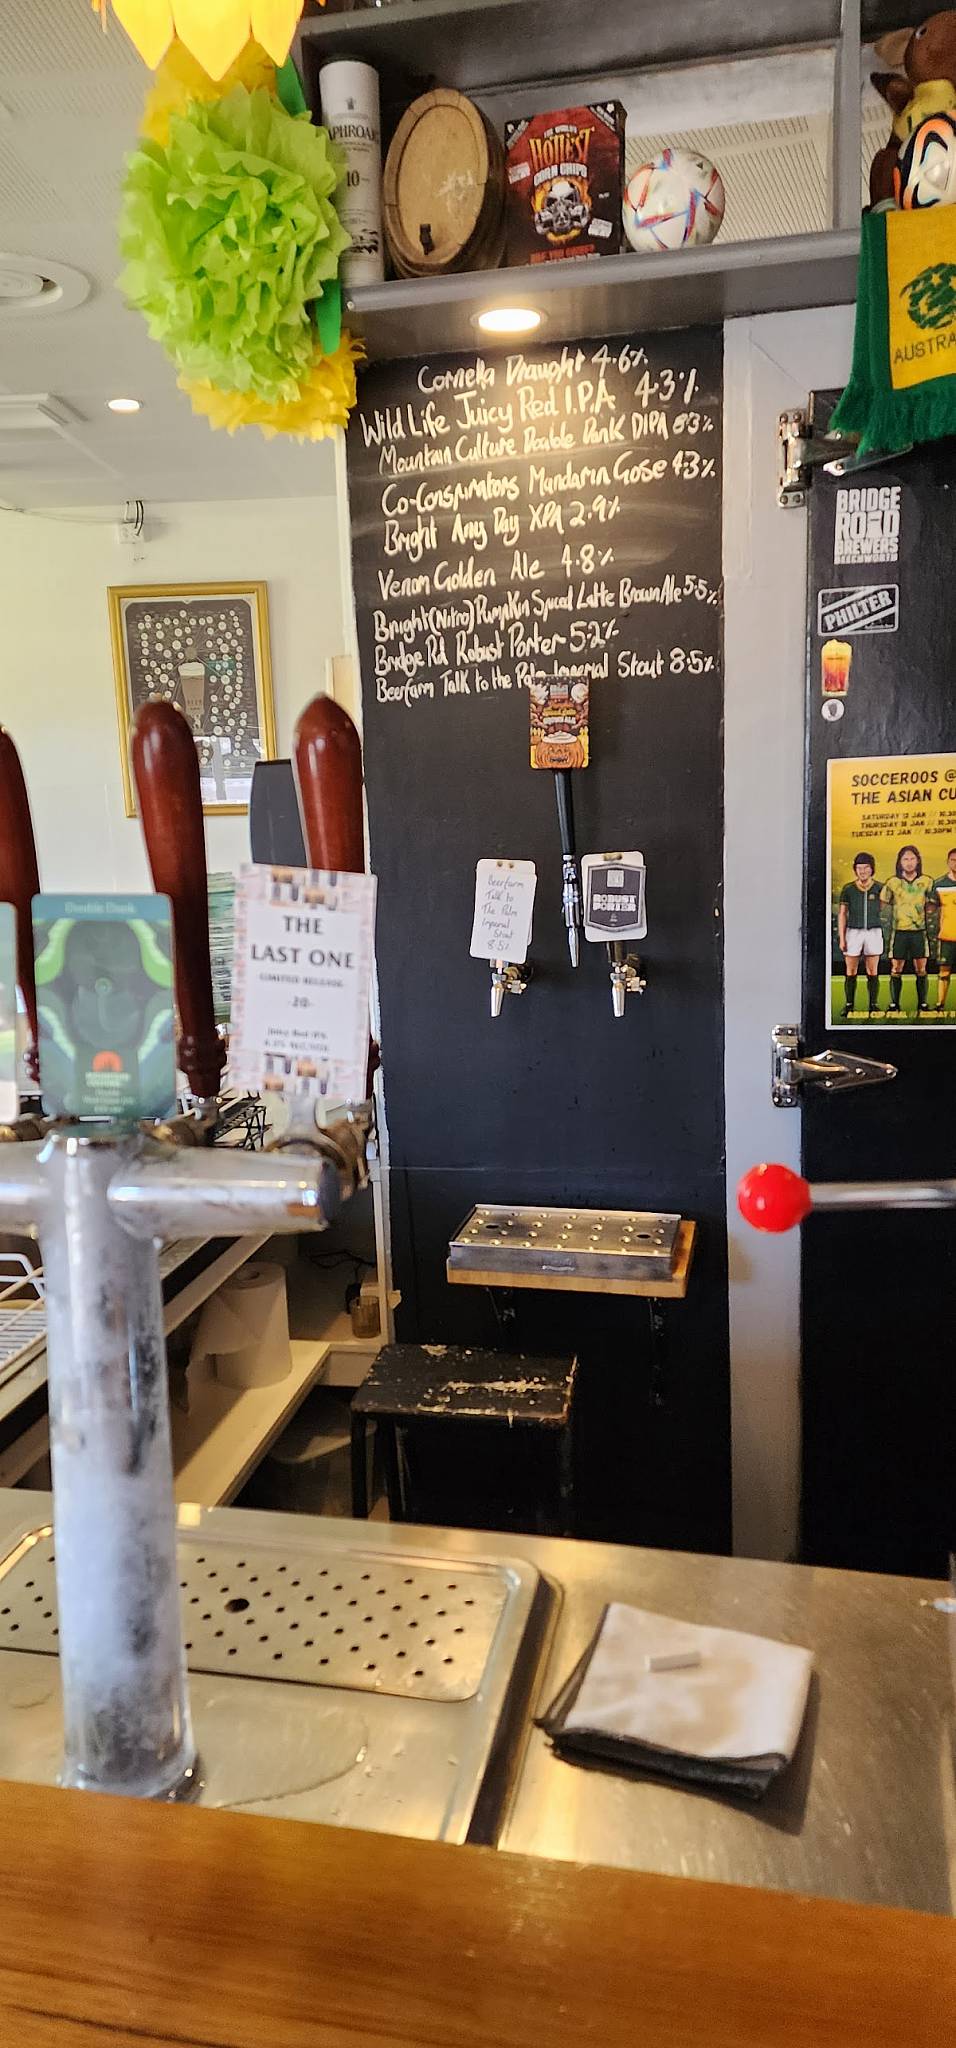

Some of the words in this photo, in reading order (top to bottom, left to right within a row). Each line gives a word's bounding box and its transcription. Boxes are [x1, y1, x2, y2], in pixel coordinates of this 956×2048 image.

[529, 127, 594, 172] HOTTEST
[346, 169, 360, 188] 10
[504, 346, 586, 388] Draught
[591, 344, 650, 378] 4.6%
[359, 406, 404, 448] Wild
[406, 400, 450, 438] Life
[453, 390, 514, 433] Juicy
[517, 384, 560, 423] Red
[634, 367, 700, 409] 4.3%
[379, 443, 452, 477] Mountain
[455, 430, 518, 464] Culture
[522, 422, 577, 457] Double
[631, 410, 670, 441] DIPA
[528, 460, 612, 498] Mandarin
[612, 449, 669, 487] Gose
[836, 486, 901, 512] BRIDGE
[383, 515, 438, 563] Bright
[451, 512, 489, 551] Any
[492, 506, 522, 547] Day
[529, 499, 566, 536] XPA
[568, 494, 622, 528] 2.9%
[835, 510, 900, 540] ROAD
[834, 537, 899, 556] BREWERS
[377, 568, 431, 601] Venom
[433, 556, 497, 592] Golden
[509, 550, 546, 582] Ale
[560, 542, 616, 578] 4.8%
[576, 580, 616, 610] Latte
[619, 577, 662, 609] Brown
[824, 590, 893, 631] PHILTER
[374, 641, 425, 678] Bridge
[425, 633, 450, 668] Rd
[455, 628, 505, 667] Robust
[507, 621, 567, 658] Porter
[375, 676, 435, 707] Beerfarm
[475, 668, 490, 693] to
[491, 664, 512, 690] the
[617, 650, 665, 679] Stout
[851, 771, 939, 787] SOCCEROOS
[851, 791, 881, 805] THE
[887, 789, 932, 804] ASIAN
[860, 821, 897, 830] THURSDAY
[861, 813, 899, 821] SATURDAY
[592, 902, 637, 912] PORTER
[593, 894, 637, 903] ROBUST
[282, 914, 325, 935] THE
[251, 943, 302, 964] LAST
[308, 948, 355, 970] ONE
